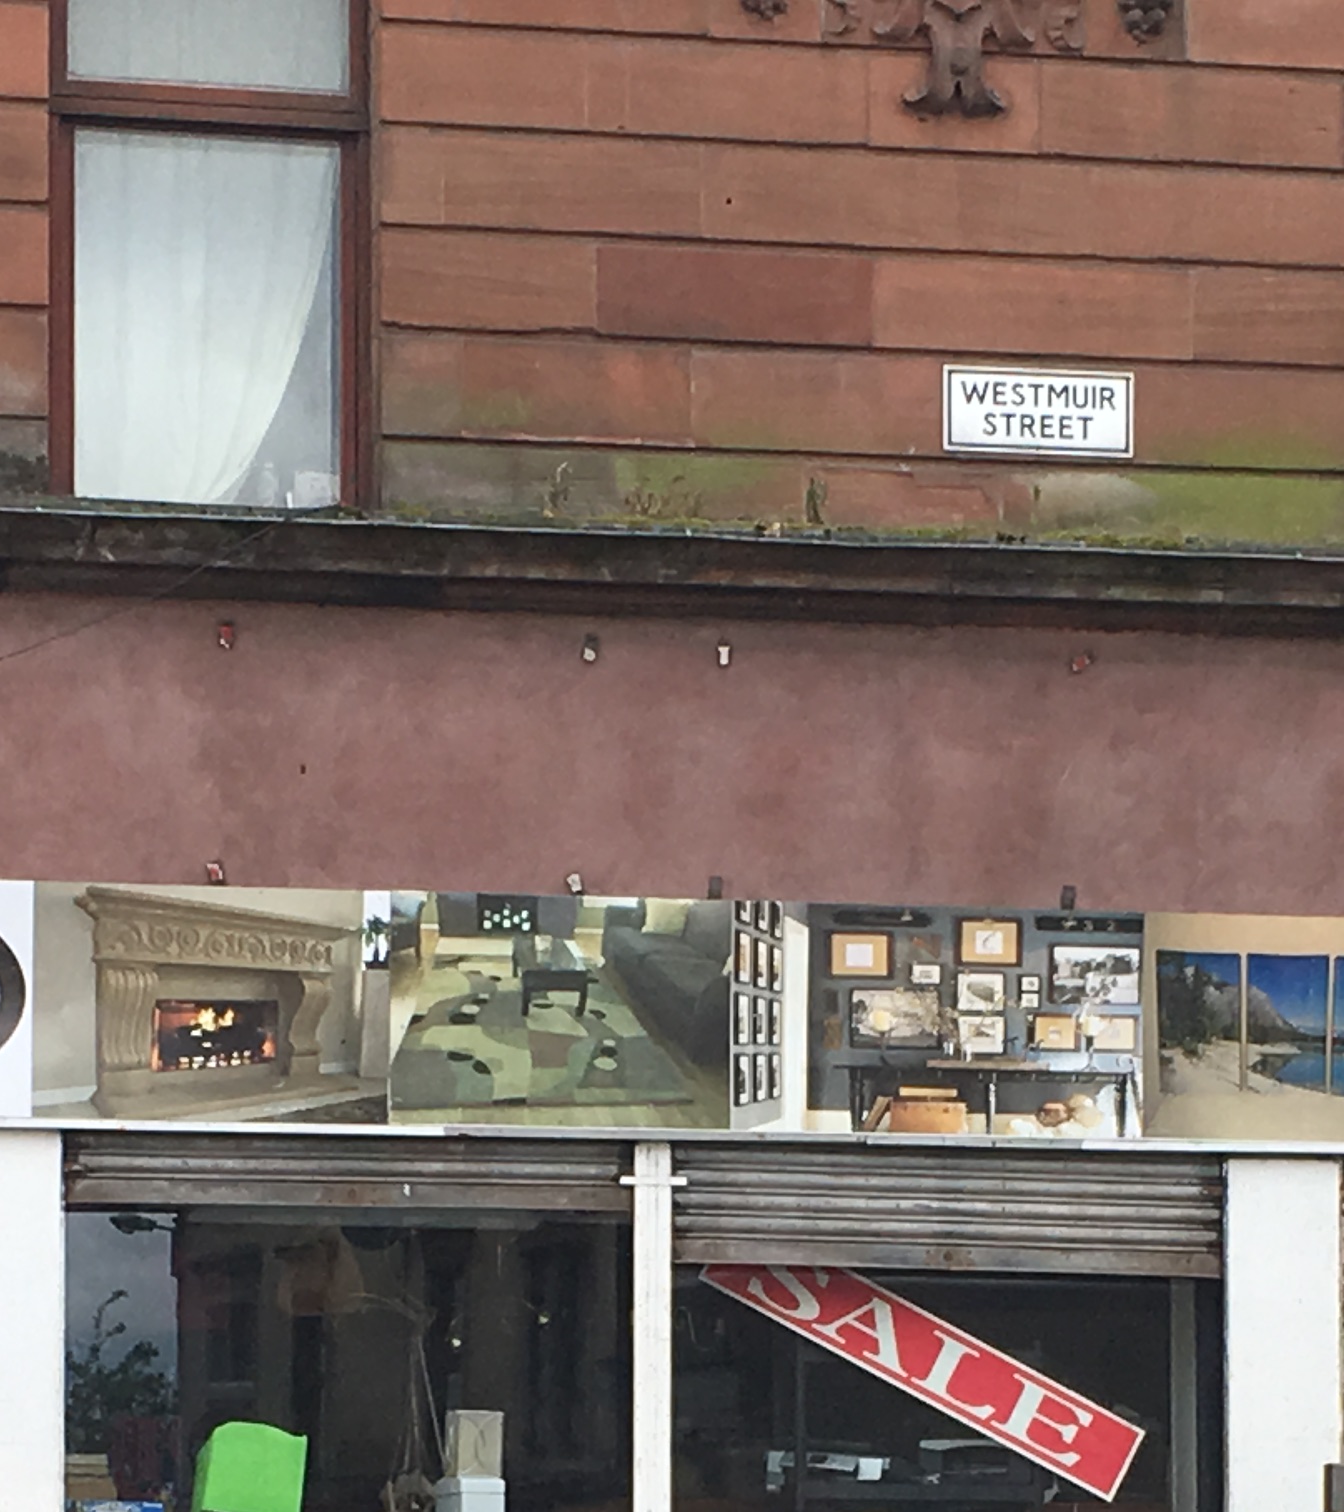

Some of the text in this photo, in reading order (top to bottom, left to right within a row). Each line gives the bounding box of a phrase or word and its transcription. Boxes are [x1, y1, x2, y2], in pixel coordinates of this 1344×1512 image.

[960, 381, 1117, 411] WESTMUIR
[982, 412, 1094, 441] STREET
[747, 1265, 1094, 1467] SALE
